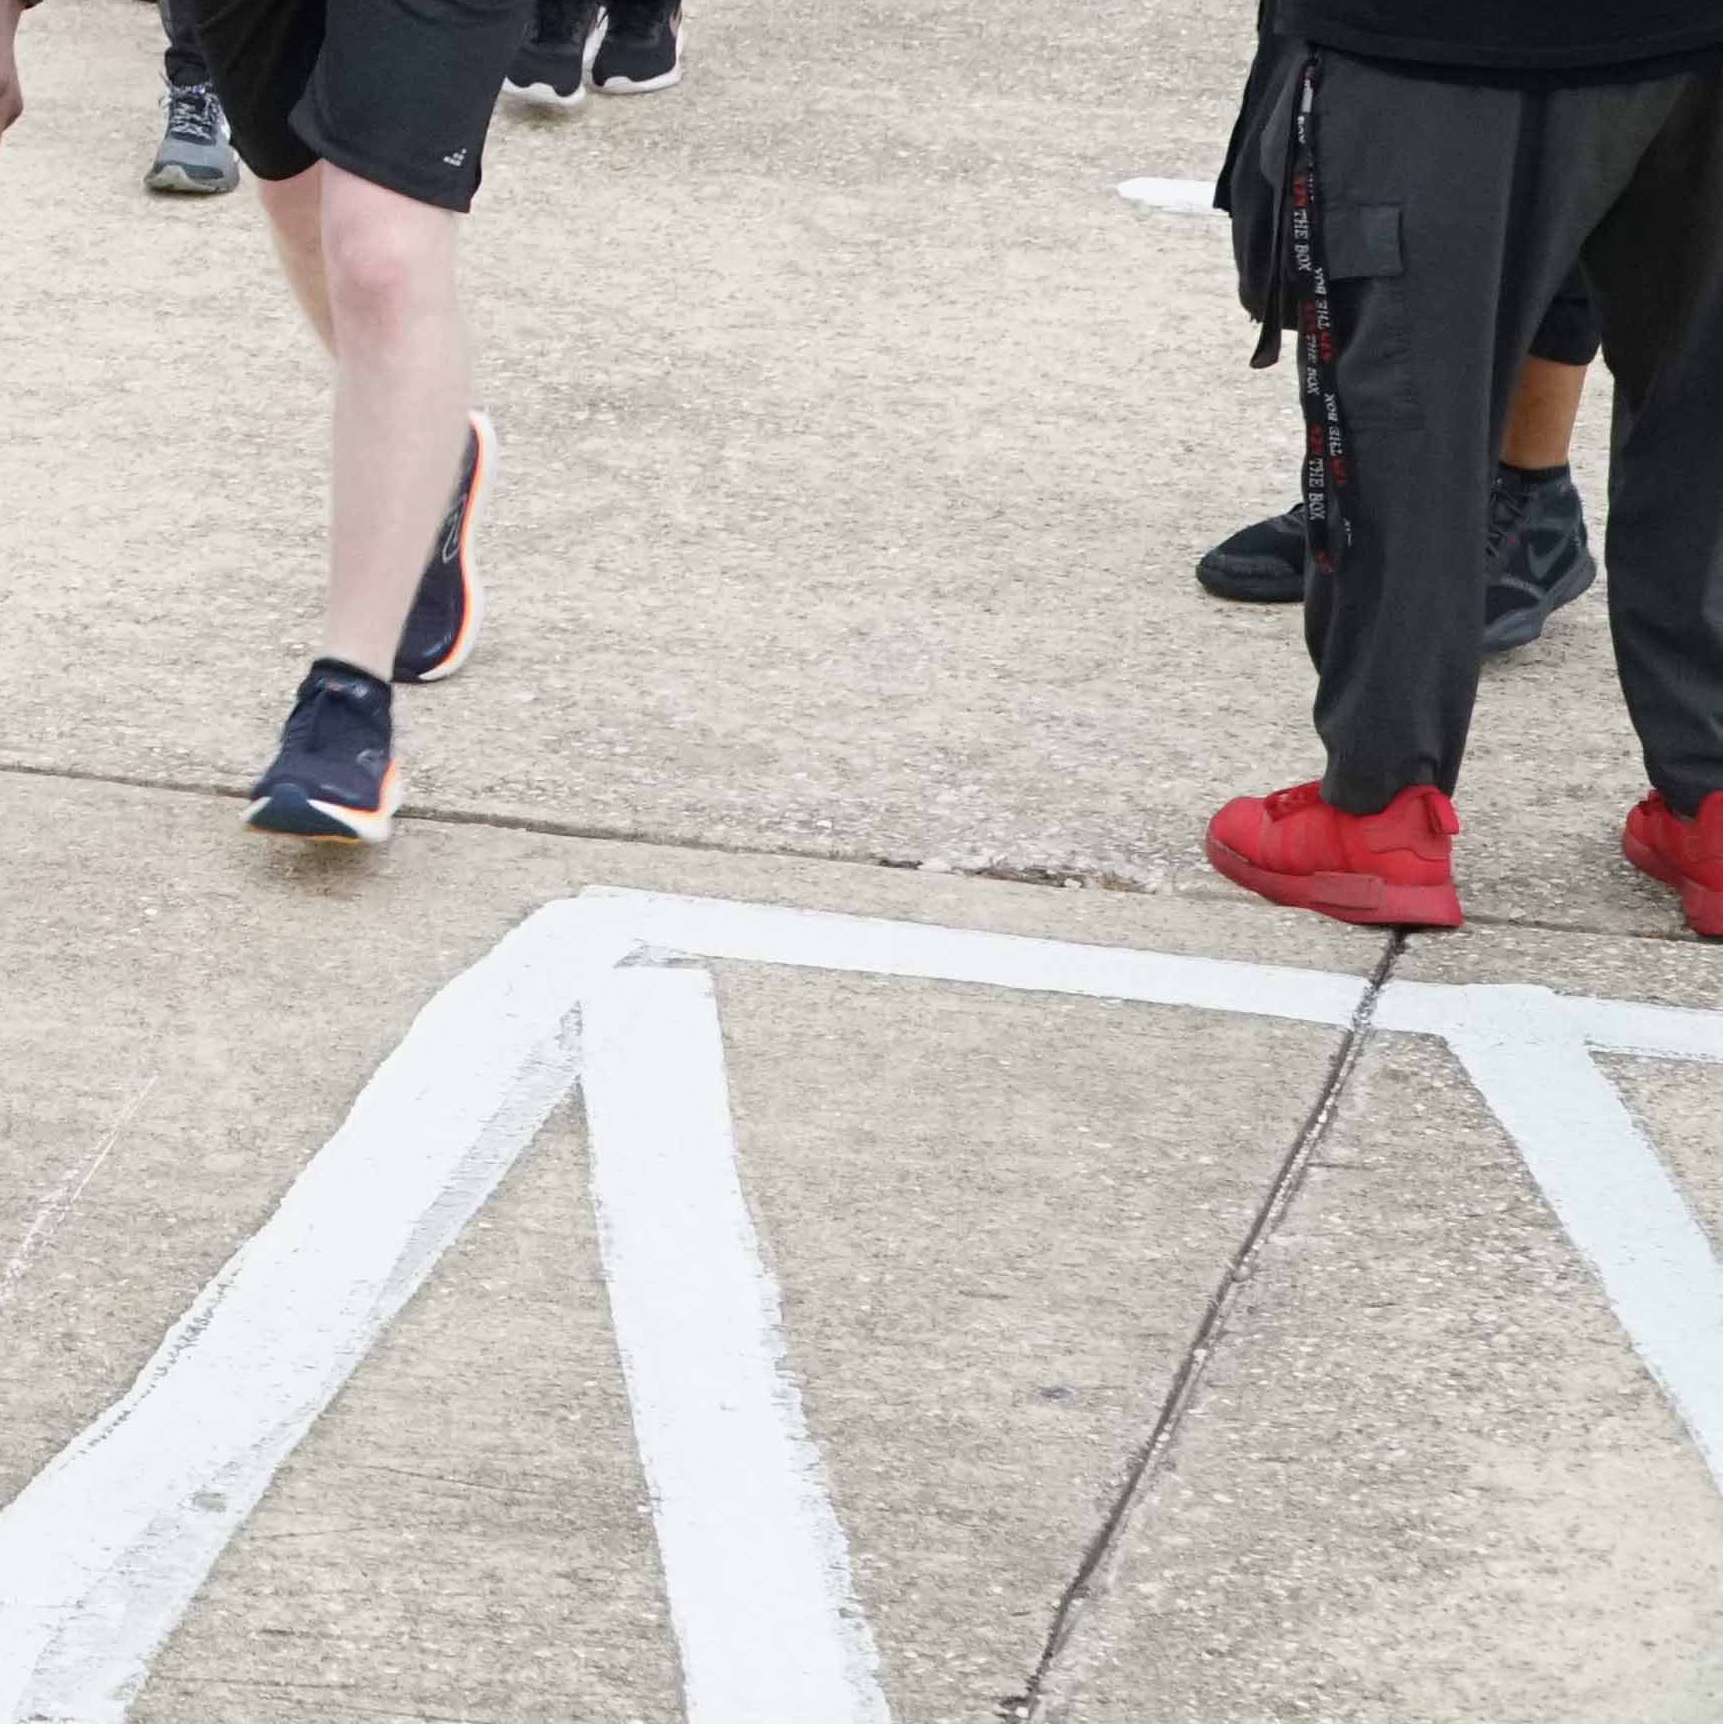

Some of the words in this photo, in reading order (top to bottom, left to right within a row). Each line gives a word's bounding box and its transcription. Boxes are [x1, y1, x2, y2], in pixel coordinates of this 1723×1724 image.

[1294, 244, 1312, 271] BOX
[1308, 457, 1325, 488] THE
[1308, 492, 1326, 520] BOX
